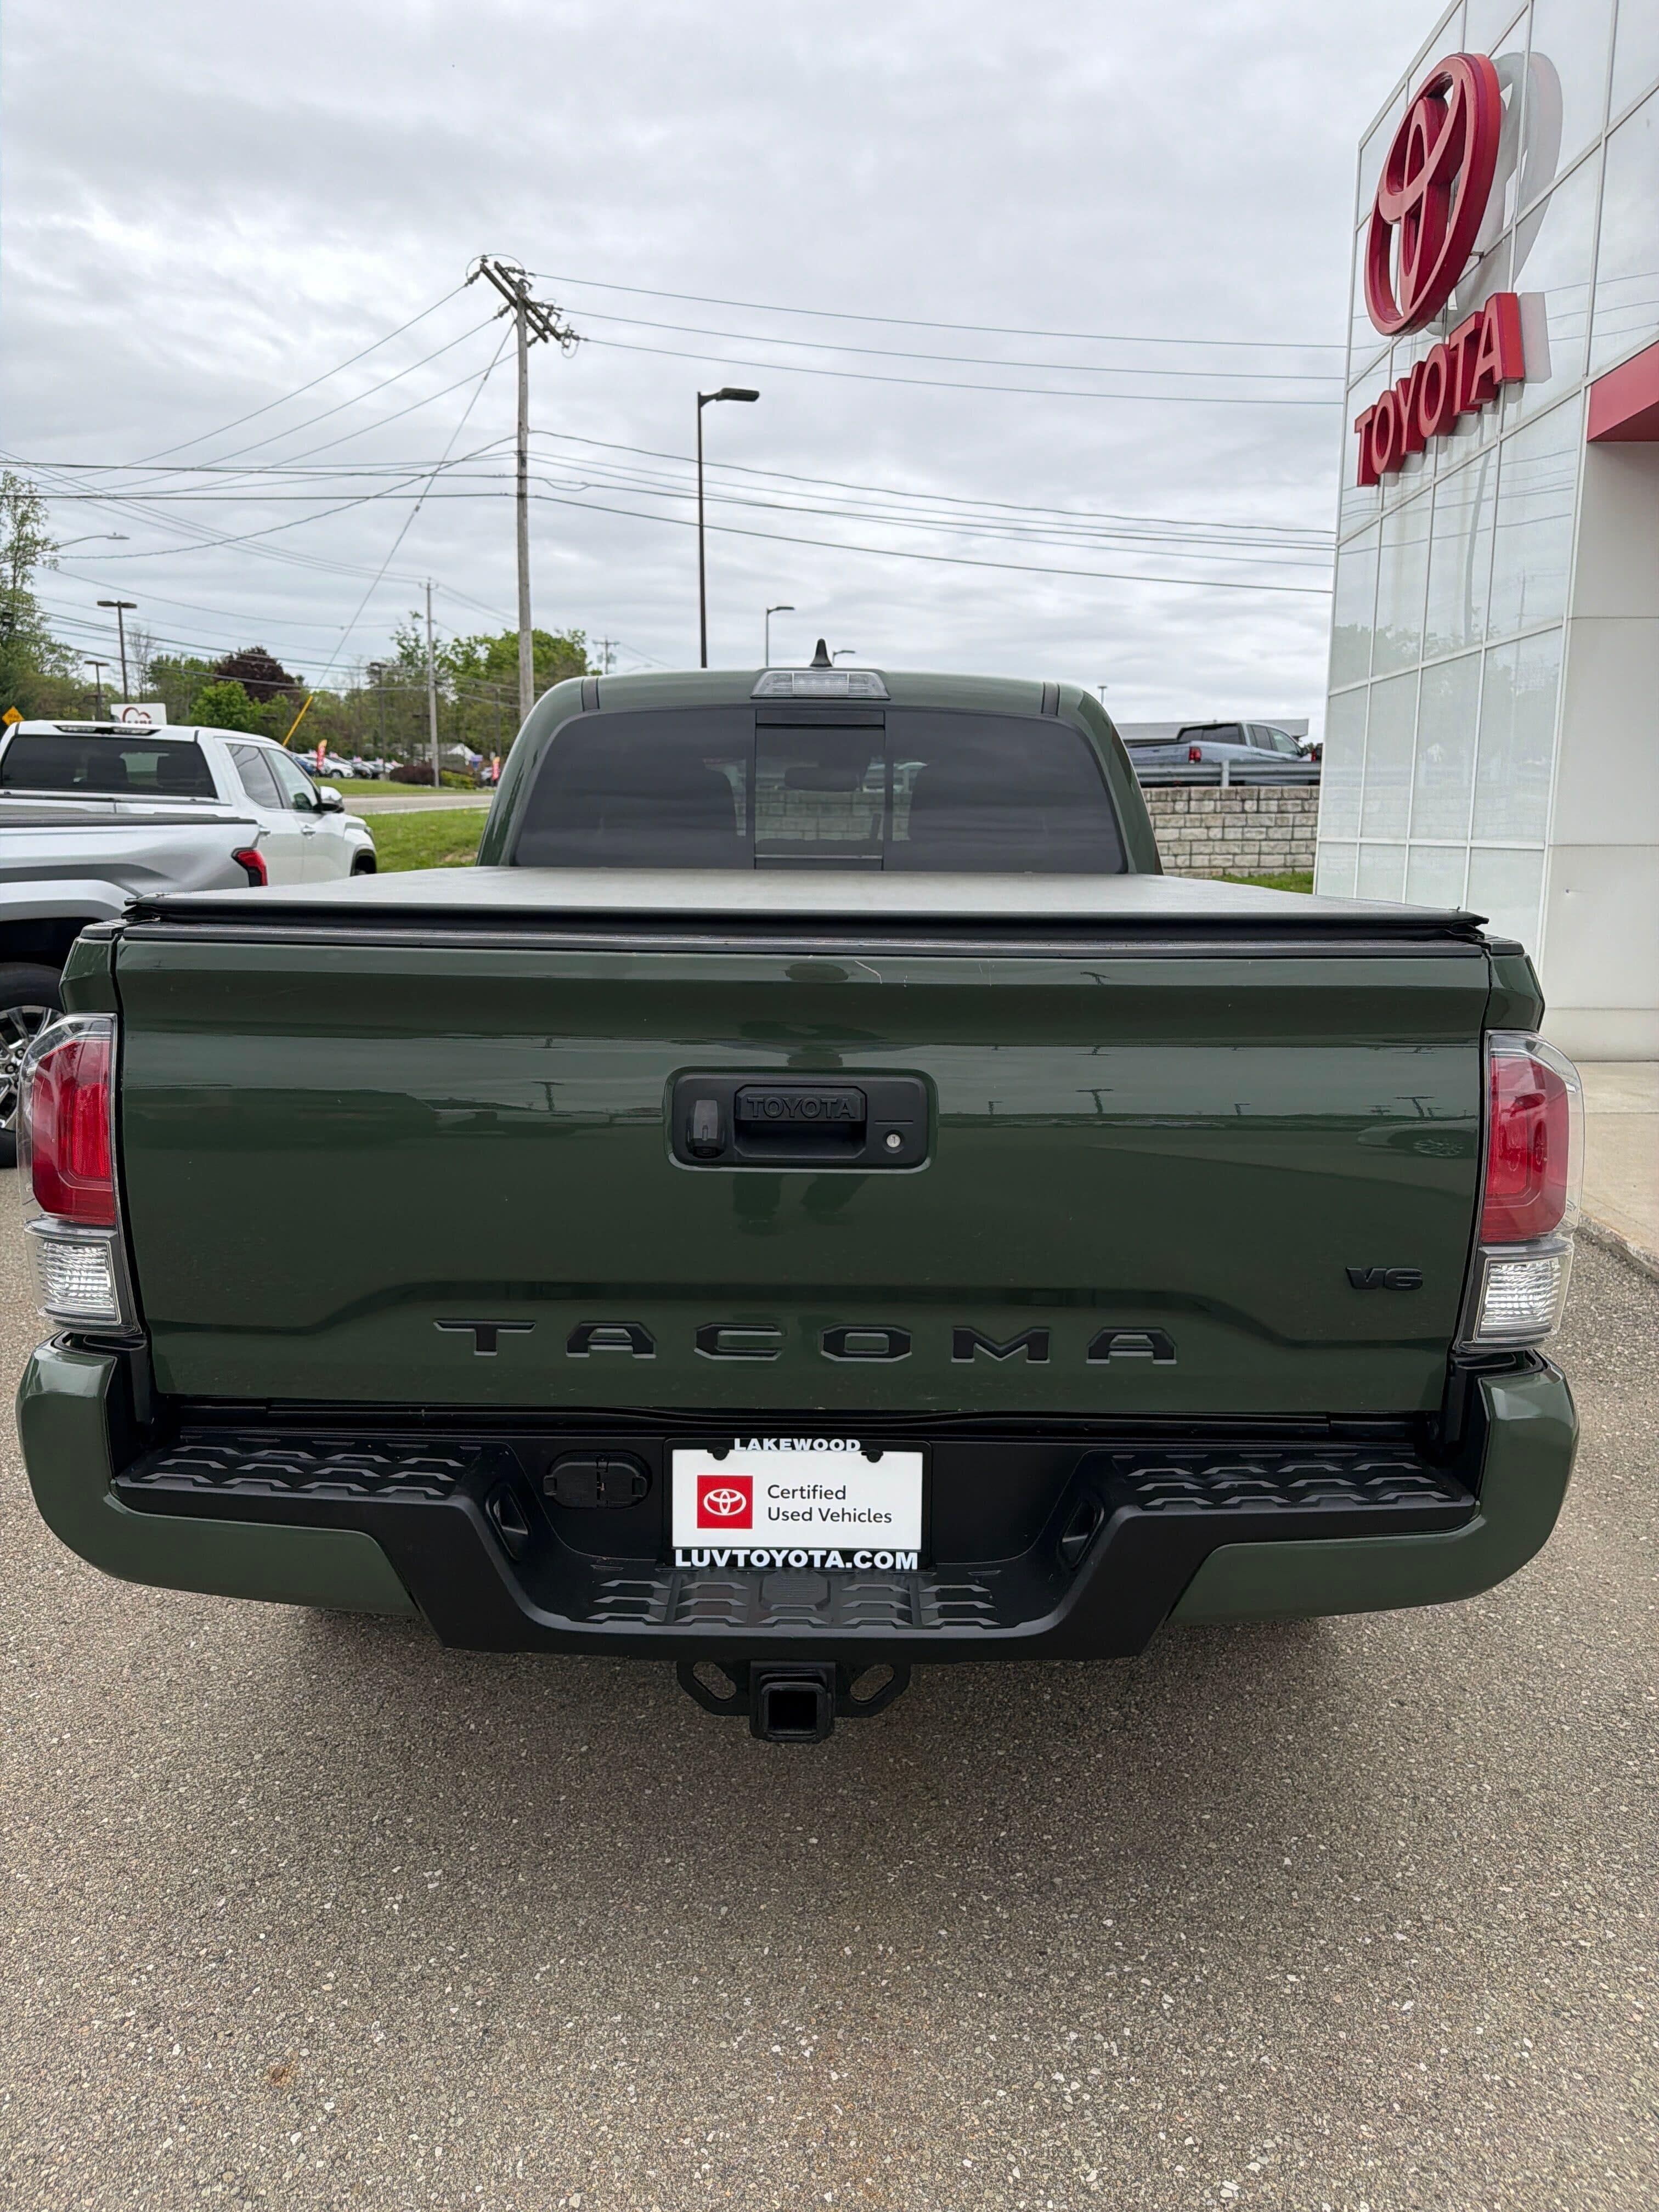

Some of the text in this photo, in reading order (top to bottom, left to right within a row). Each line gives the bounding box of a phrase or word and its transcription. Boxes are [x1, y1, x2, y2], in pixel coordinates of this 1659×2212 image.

[1355, 292, 1524, 487] TOYOTA
[747, 1097, 856, 1119] TOYOTA
[1345, 1267, 1423, 1290] V6
[434, 1319, 1177, 1364] TACOMA
[733, 1438, 861, 1452] LAKEWOOD
[768, 1485, 847, 1500] Certified
[768, 1507, 893, 1523] Used Vehicles
[675, 1549, 918, 1570] LUVTOYOTA.COM
